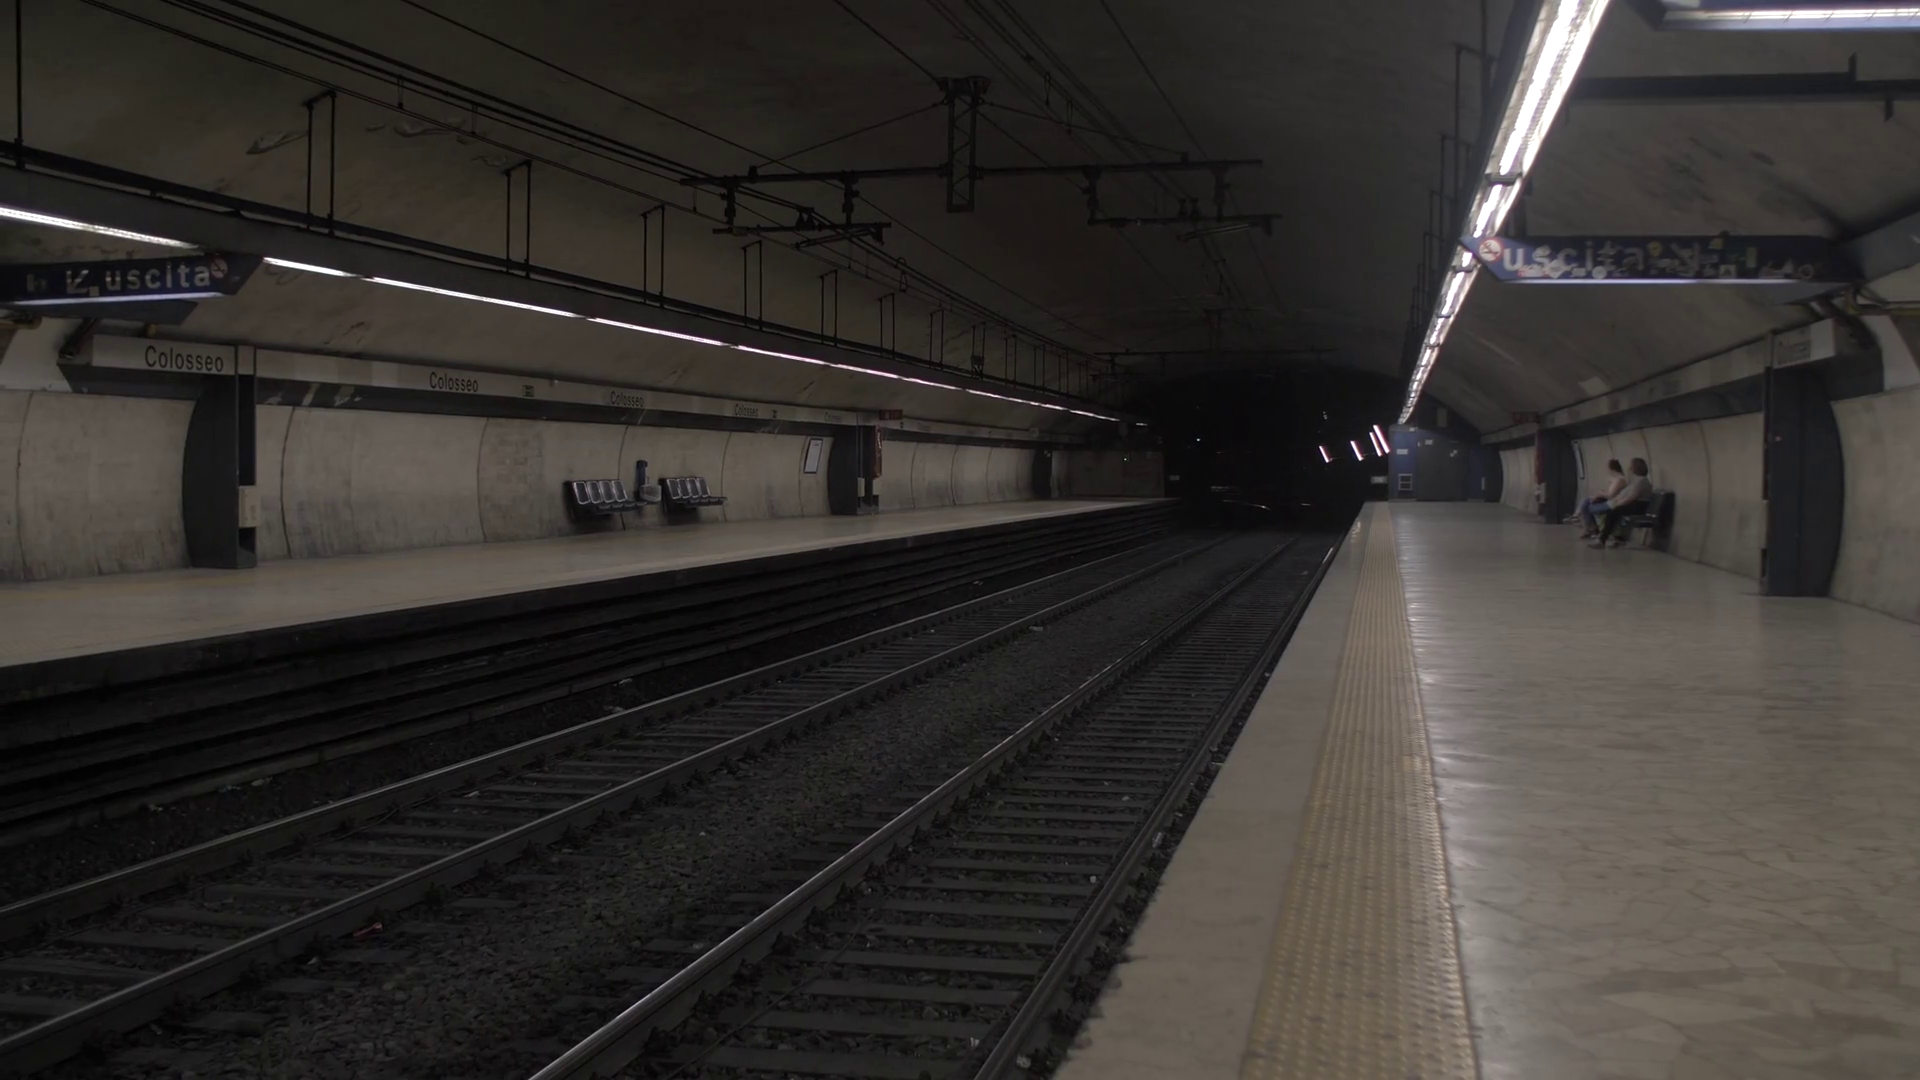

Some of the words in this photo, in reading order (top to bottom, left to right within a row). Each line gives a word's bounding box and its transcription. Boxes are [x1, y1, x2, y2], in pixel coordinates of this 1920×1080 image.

[105, 261, 210, 291] uscita
[145, 345, 224, 373] Colosseo
[429, 371, 479, 393] Colosseo
[610, 390, 644, 408] Colosseo
